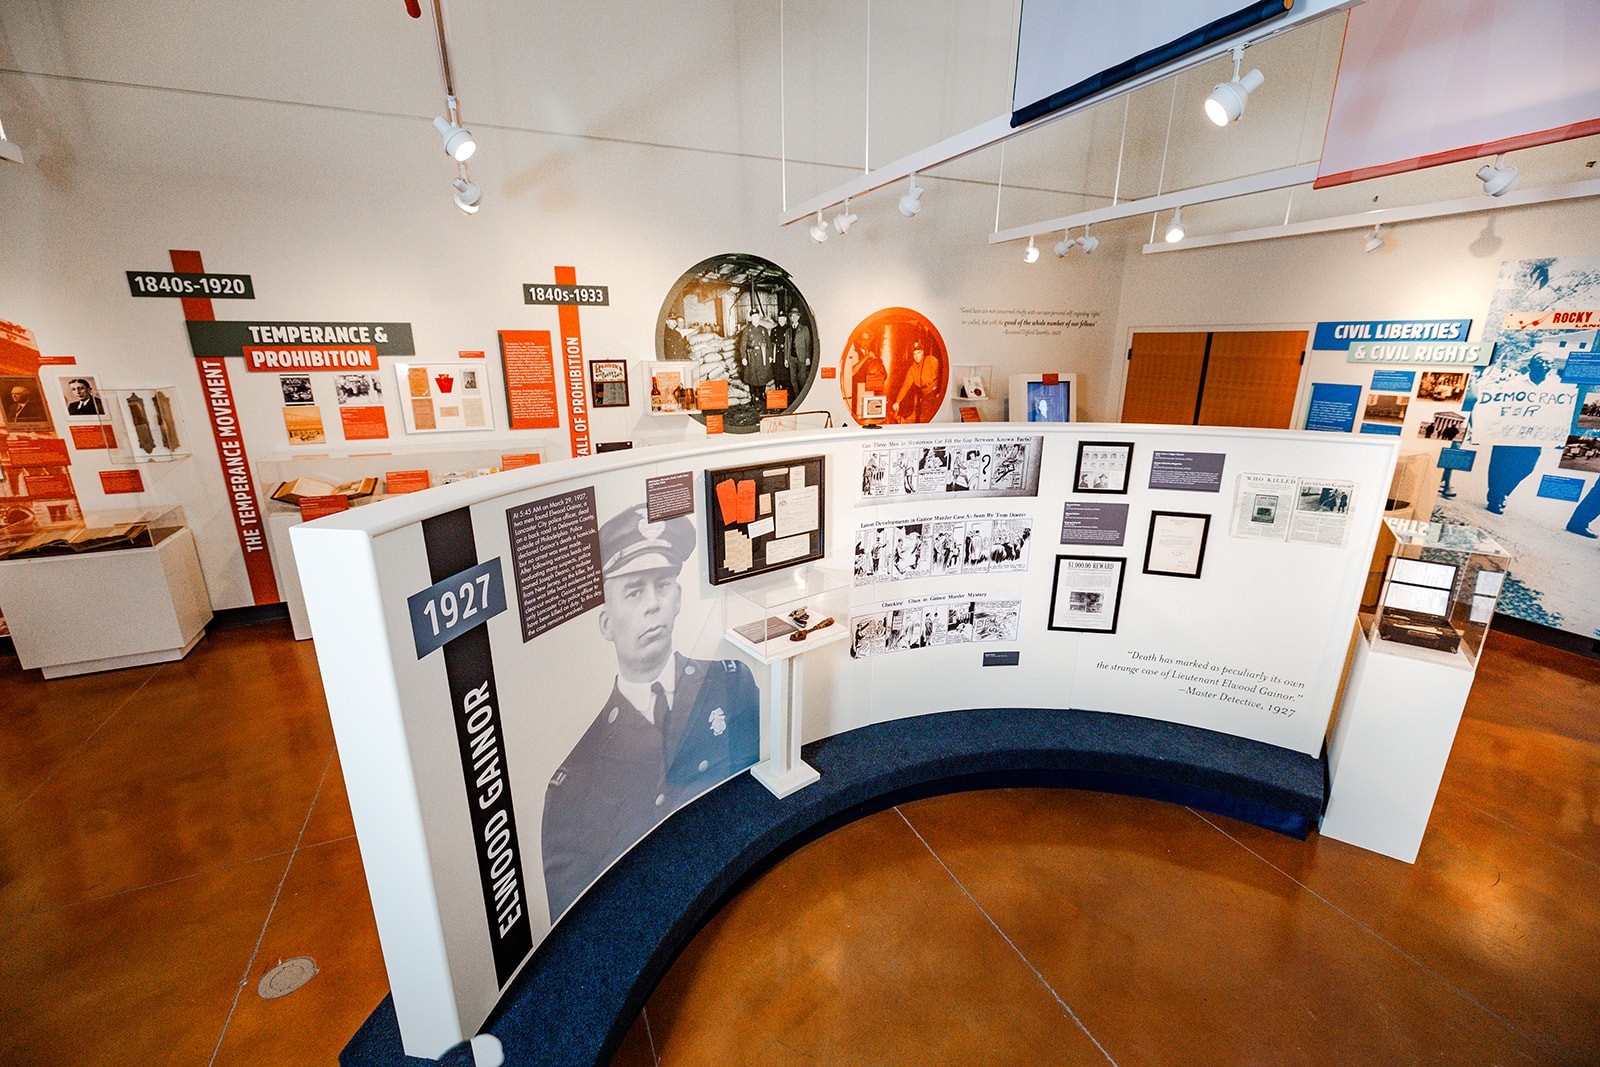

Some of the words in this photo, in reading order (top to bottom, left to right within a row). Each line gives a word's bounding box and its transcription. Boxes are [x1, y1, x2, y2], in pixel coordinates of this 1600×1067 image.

[134, 276, 246, 294] 1840s-1920
[529, 288, 604, 302] 1840s-1933
[1553, 312, 1593, 323] ROCKY
[248, 326, 370, 343] TEMPERANCE
[374, 328, 388, 343] &
[1334, 324, 1372, 339] CIVIL
[1375, 322, 1462, 339] LIBERTIES
[252, 350, 372, 368] PROHIBITION
[1354, 346, 1366, 359] &
[1370, 346, 1410, 360] CIVIL
[1414, 346, 1480, 362] RIGHTS
[566, 337, 585, 414] PROHIBITION
[202, 361, 238, 437] MOVEMENT
[1480, 392, 1576, 404] DEMOCRACY
[574, 418, 588, 432] OF
[576, 436, 589, 458] ALL
[222, 440, 258, 526] TEMPERANCE
[243, 528, 264, 552] THE
[423, 573, 492, 636] 1927
[1096, 661, 1109, 670] the
[1110, 664, 1140, 674] strange
[1160, 669, 1171, 679] of
[1172, 670, 1219, 686] Lieutenant
[1222, 679, 1257, 693] Elwood
[1159, 654, 1173, 664] has
[1176, 659, 1209, 670] marked
[1220, 666, 1268, 683] peculiarly
[1270, 675, 1281, 684] its
[1284, 680, 1305, 689] own
[1268, 704, 1296, 718] 1927
[464, 680, 504, 809] GAINOR
[484, 809, 522, 939] ELWOOD
